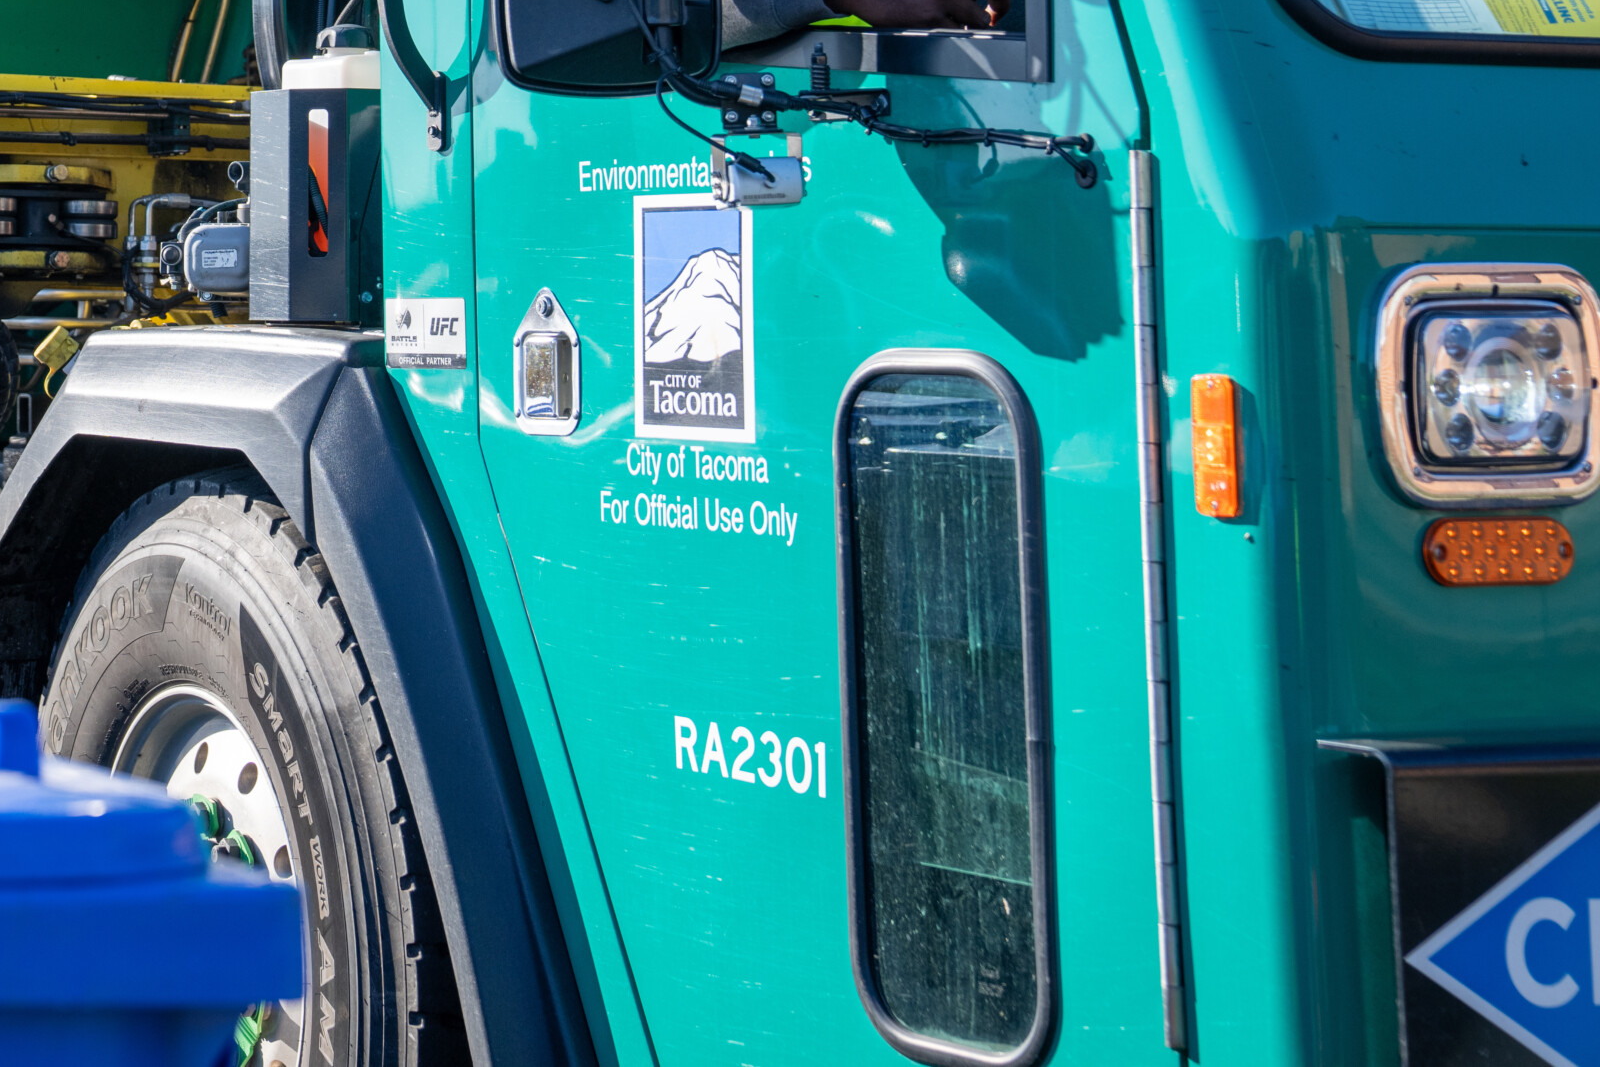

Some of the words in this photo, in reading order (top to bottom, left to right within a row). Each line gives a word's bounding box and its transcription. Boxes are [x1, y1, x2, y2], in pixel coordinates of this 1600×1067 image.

[579, 156, 713, 193] Environmental
[391, 335, 418, 343] BATTLE
[429, 317, 459, 336] UFC
[398, 356, 424, 365] OFFICIAL
[426, 357, 452, 366] PARTNER
[649, 379, 738, 418] Tacoma
[664, 374, 687, 388] CITY
[688, 374, 702, 389] OF
[626, 443, 661, 486] City
[666, 445, 686, 479] of
[690, 446, 769, 484] Tacoma
[600, 490, 629, 524] For
[634, 492, 698, 530] Official
[704, 498, 744, 535] Use
[749, 500, 798, 546] Only
[185, 582, 232, 636] Kontrol
[674, 715, 827, 799] RA2301
[311, 841, 329, 914] WORK
